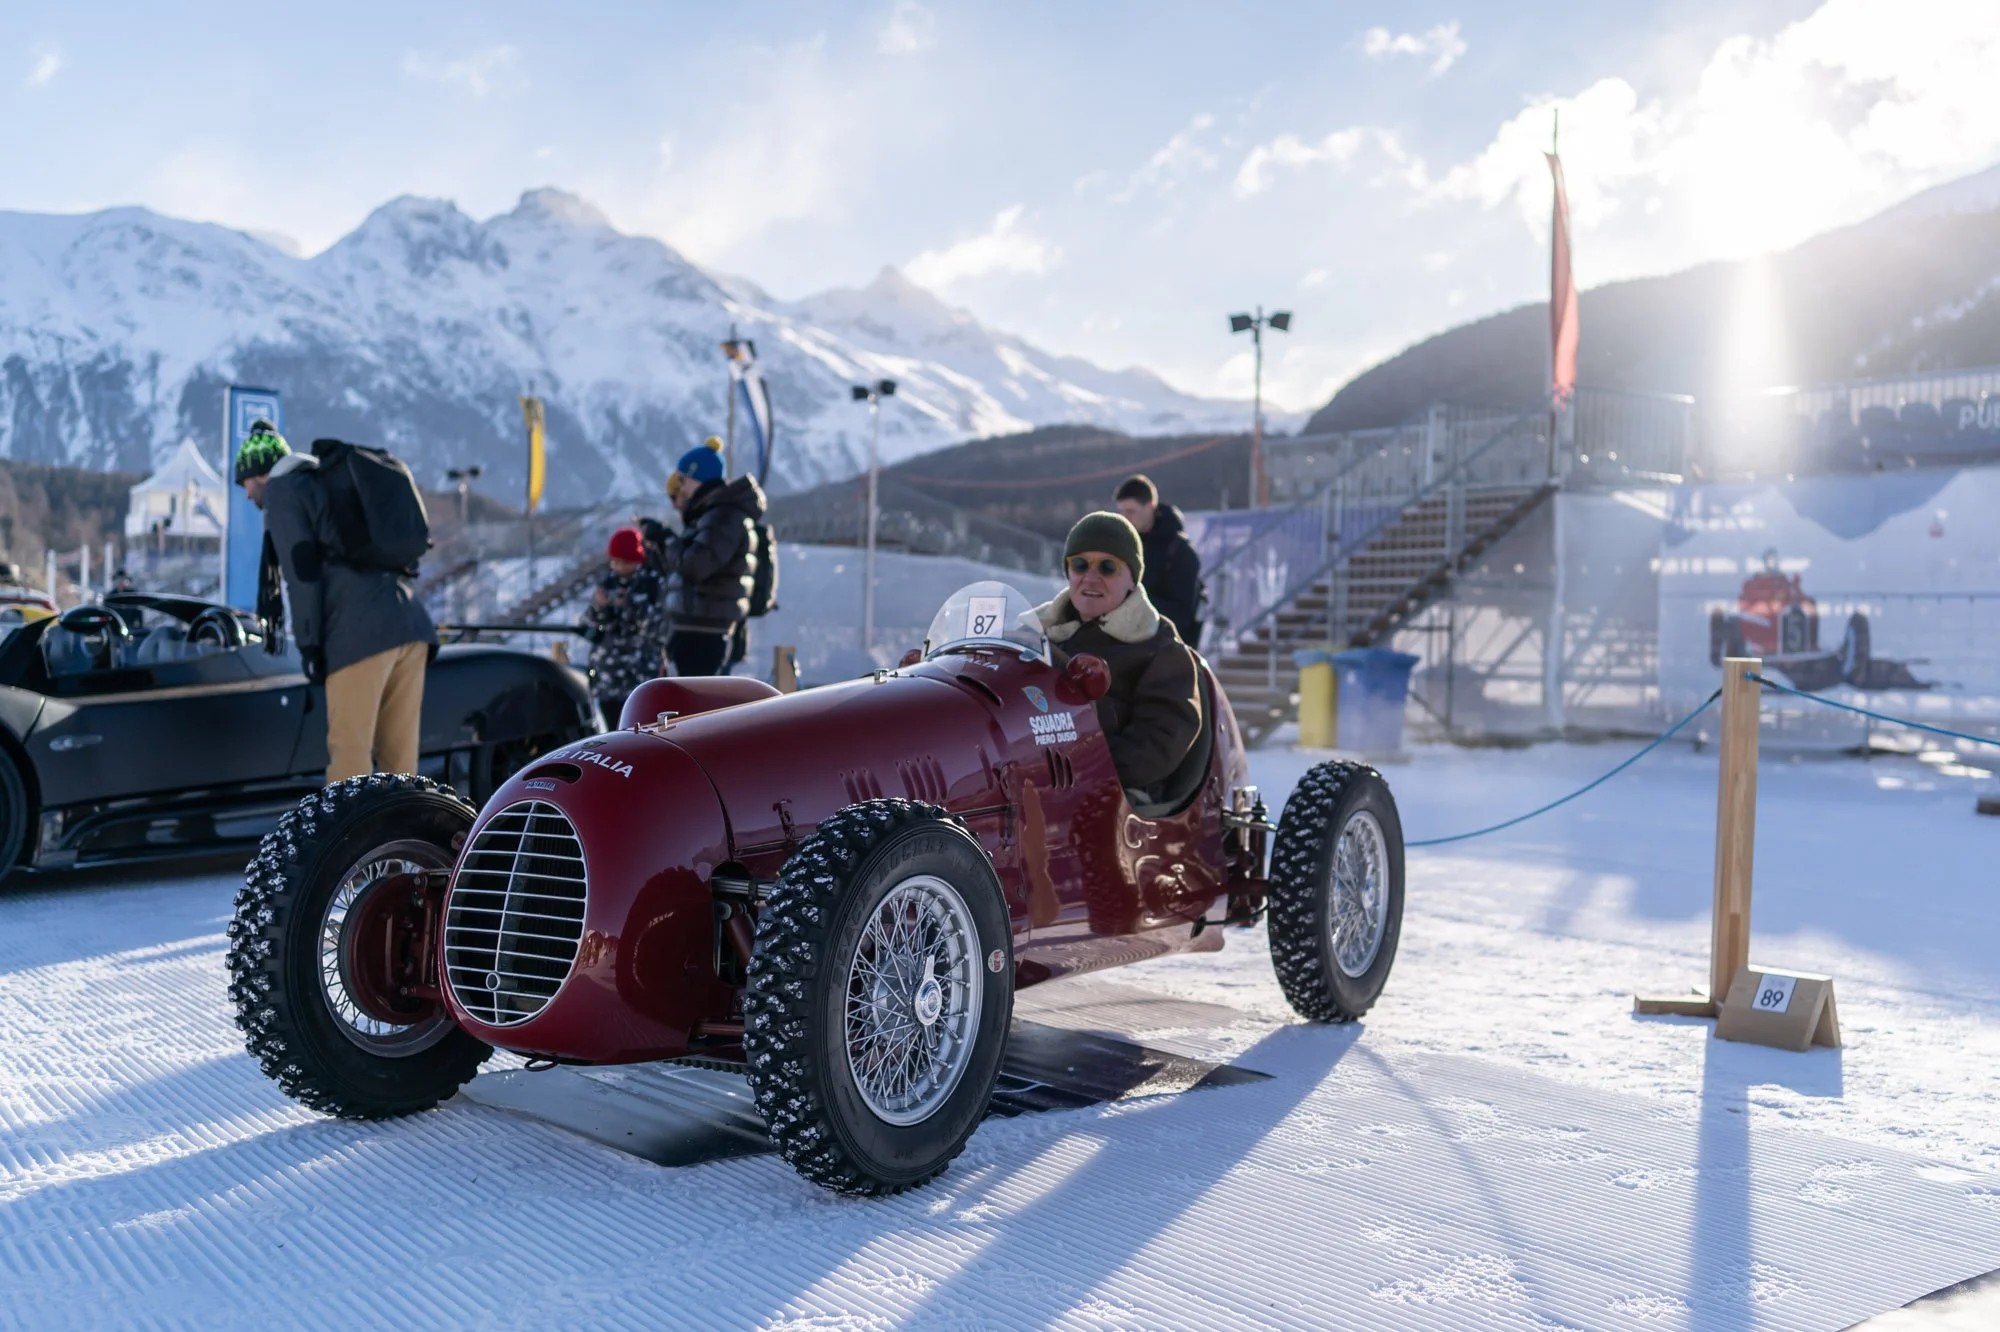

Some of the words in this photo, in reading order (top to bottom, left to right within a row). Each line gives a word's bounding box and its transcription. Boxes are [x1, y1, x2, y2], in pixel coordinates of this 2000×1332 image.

[973, 615, 996, 634] 87
[1029, 711, 1075, 735] SQUADRA
[1034, 733, 1056, 746] PIERO
[1056, 730, 1078, 743] DUSIO
[570, 750, 634, 778] ITALIA
[1760, 988, 1784, 1008] 89
